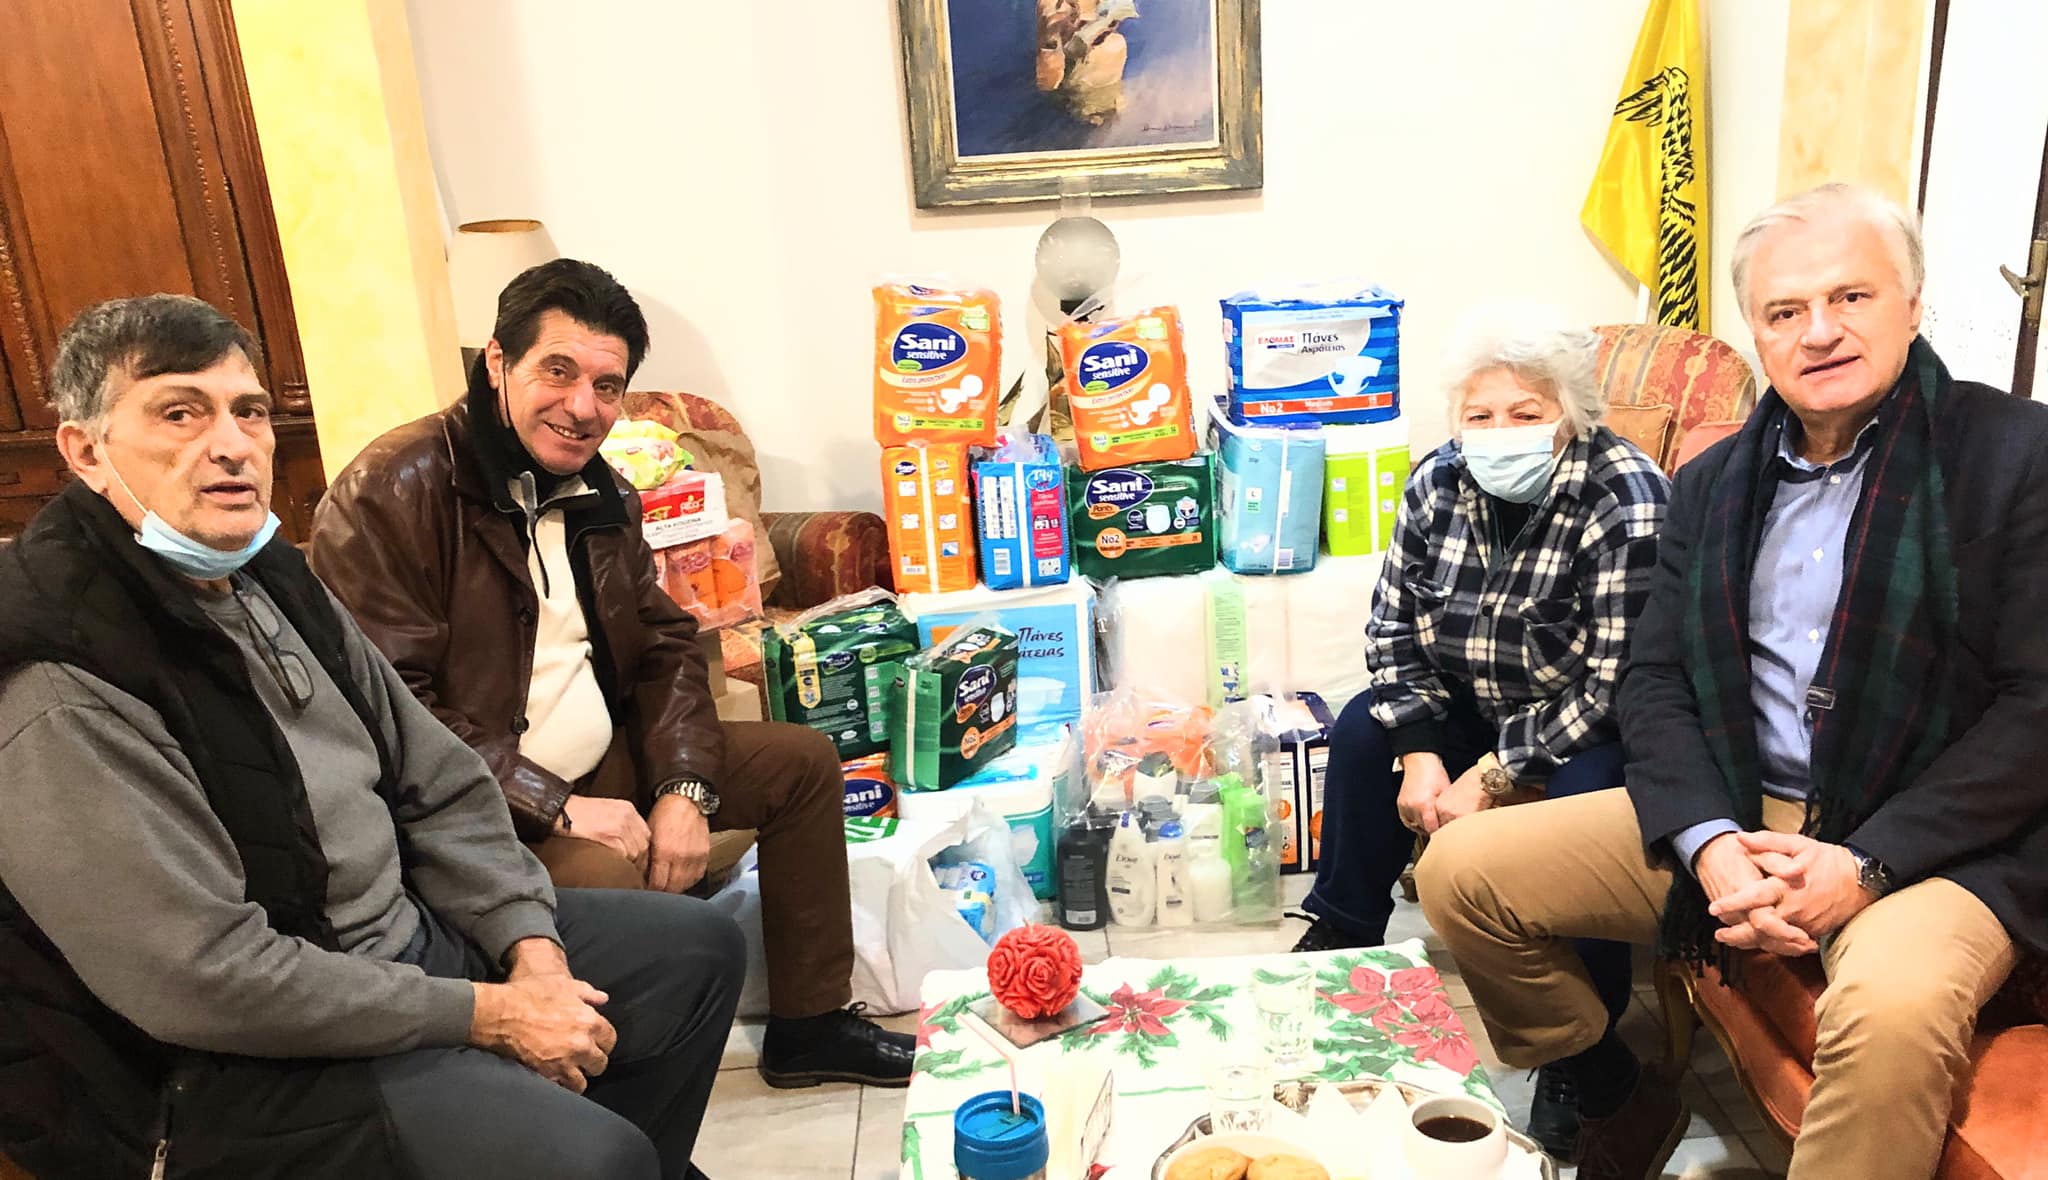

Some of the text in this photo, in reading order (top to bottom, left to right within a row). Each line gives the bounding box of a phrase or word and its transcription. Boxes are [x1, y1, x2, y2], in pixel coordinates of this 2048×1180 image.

[899, 333, 956, 351] Sani
[1302, 332, 1339, 344] Πάνες
[905, 350, 948, 361] sensitive
[1083, 348, 1139, 373] Sani
[1091, 366, 1131, 381] sensitive
[1092, 476, 1144, 495] Sani
[1098, 492, 1136, 502] sensitive
[1093, 503, 1113, 512] Pants
[1101, 534, 1120, 545] No2
[1018, 626, 1064, 642] Πάνες
[1018, 647, 1065, 658] άτειας
[958, 669, 991, 698] Sani
[843, 784, 883, 805] ani
[1115, 854, 1138, 863] Dove
